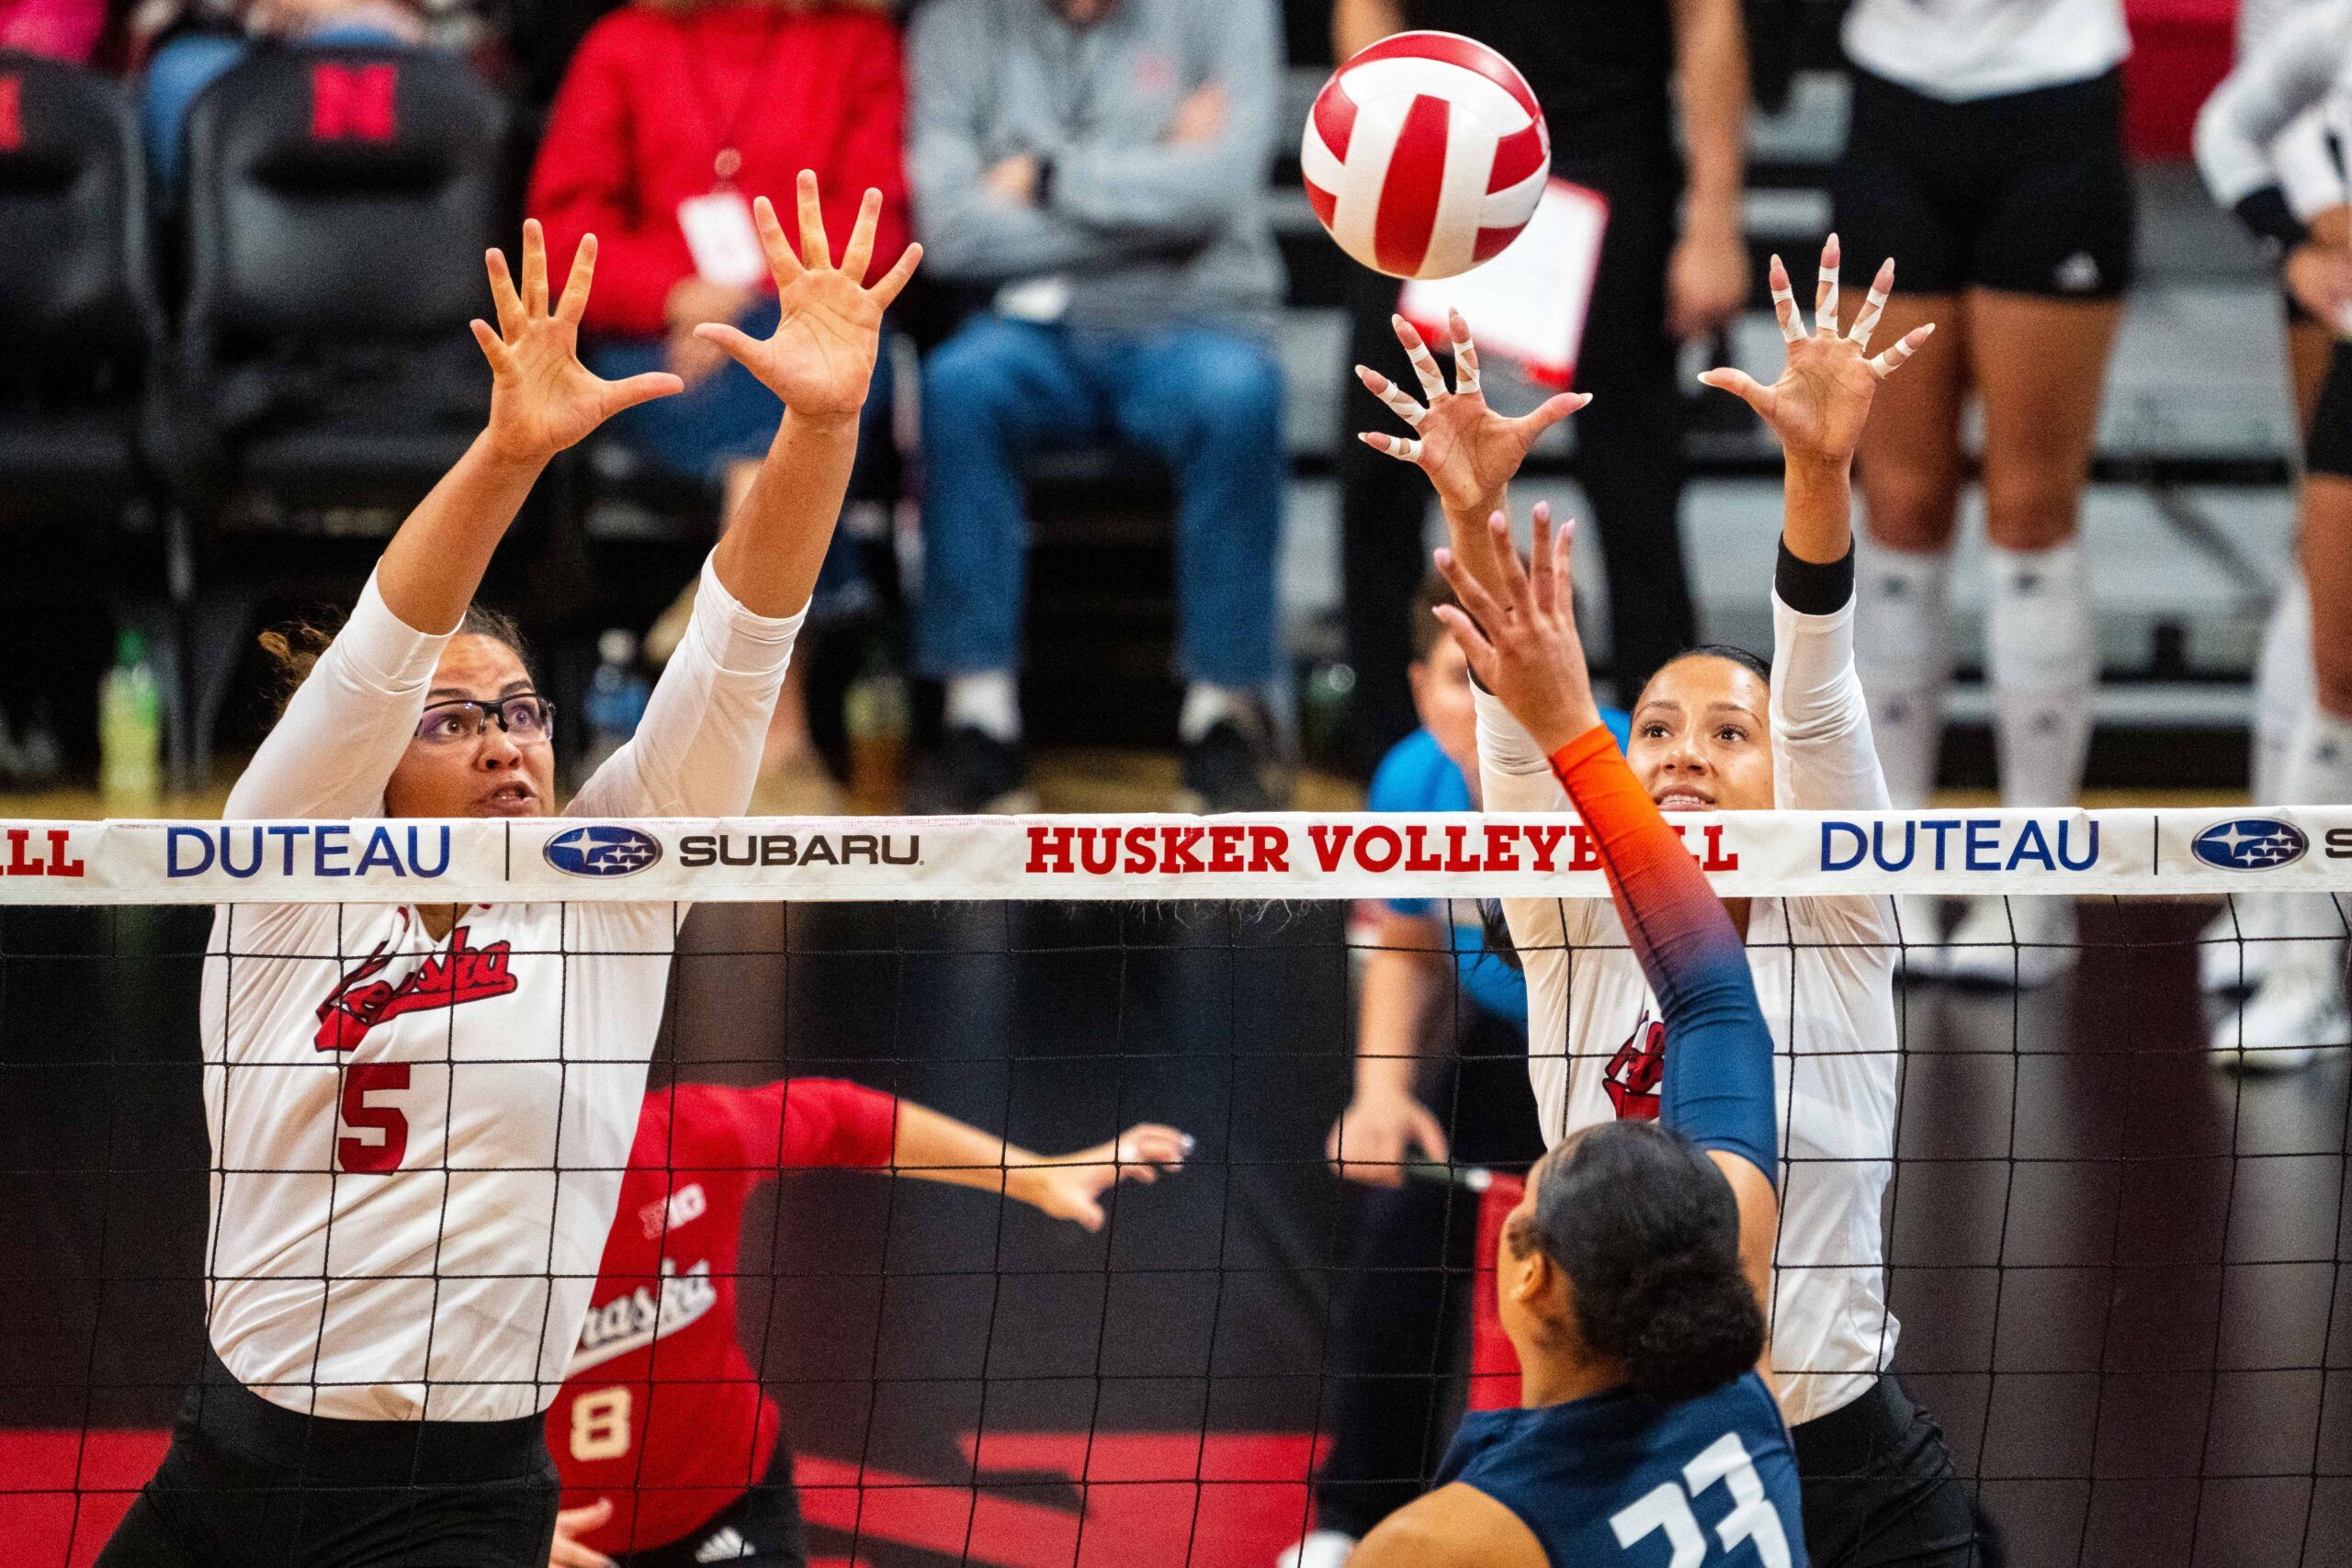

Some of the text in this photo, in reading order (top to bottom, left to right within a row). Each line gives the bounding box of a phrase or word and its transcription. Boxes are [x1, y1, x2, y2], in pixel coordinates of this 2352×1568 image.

[0, 829, 85, 877] LL
[167, 825, 450, 877] DUTEAU
[679, 834, 920, 866] SUBARU
[1024, 825, 1739, 874] HUSKER VOLLEYBL
[1820, 819, 2099, 872] DUTEAU
[338, 1063, 411, 1176] 5
[570, 1386, 632, 1461] 8
